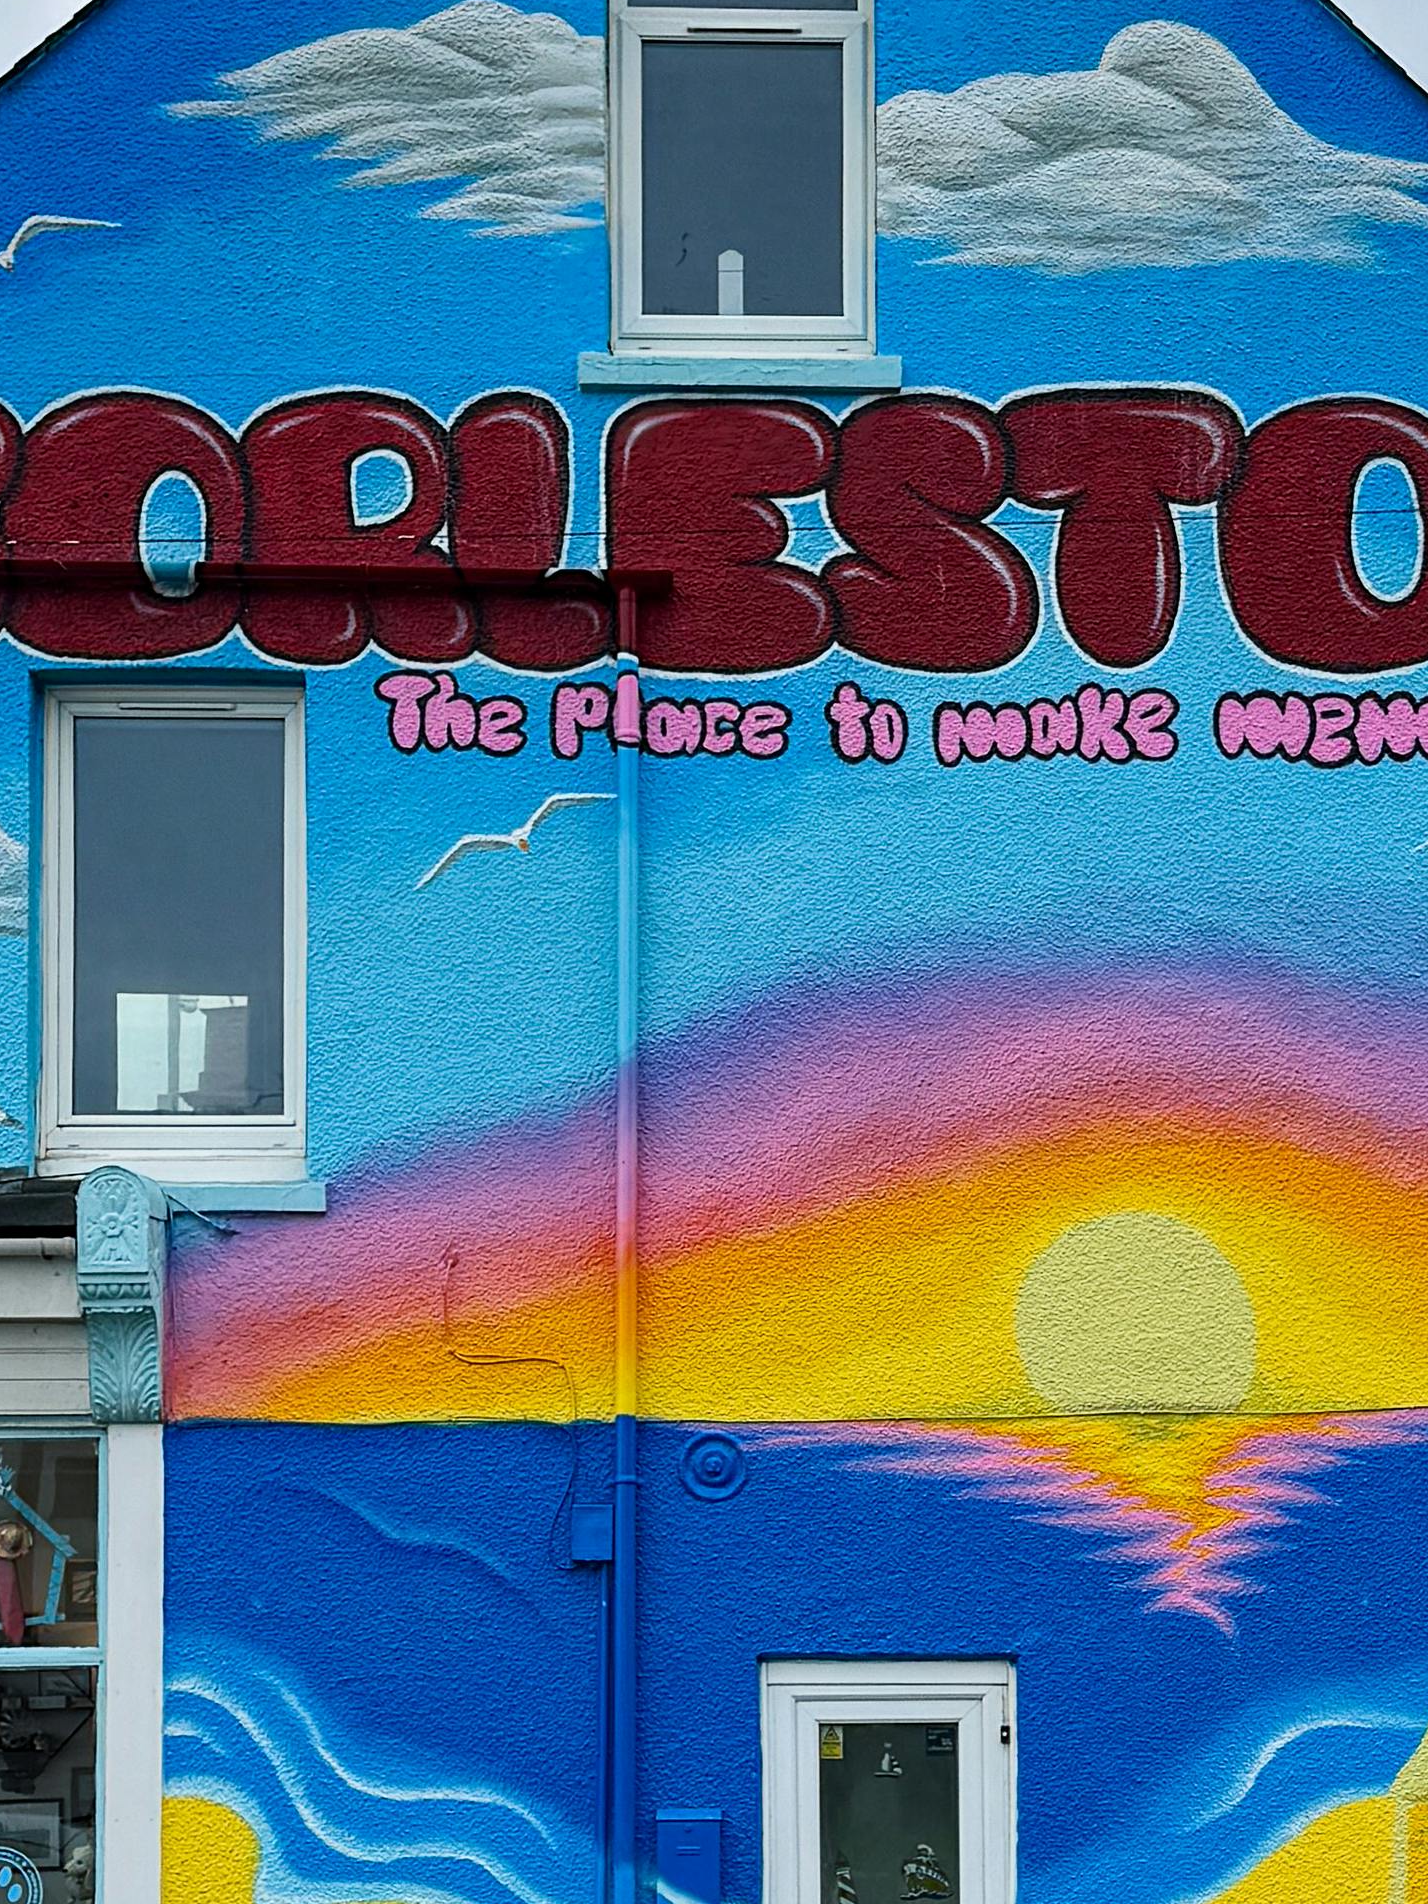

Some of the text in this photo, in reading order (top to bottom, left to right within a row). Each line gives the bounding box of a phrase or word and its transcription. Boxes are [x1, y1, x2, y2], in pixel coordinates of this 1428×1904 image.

[375, 669, 528, 756] The
[824, 680, 909, 764] to
[933, 682, 1179, 767] make
